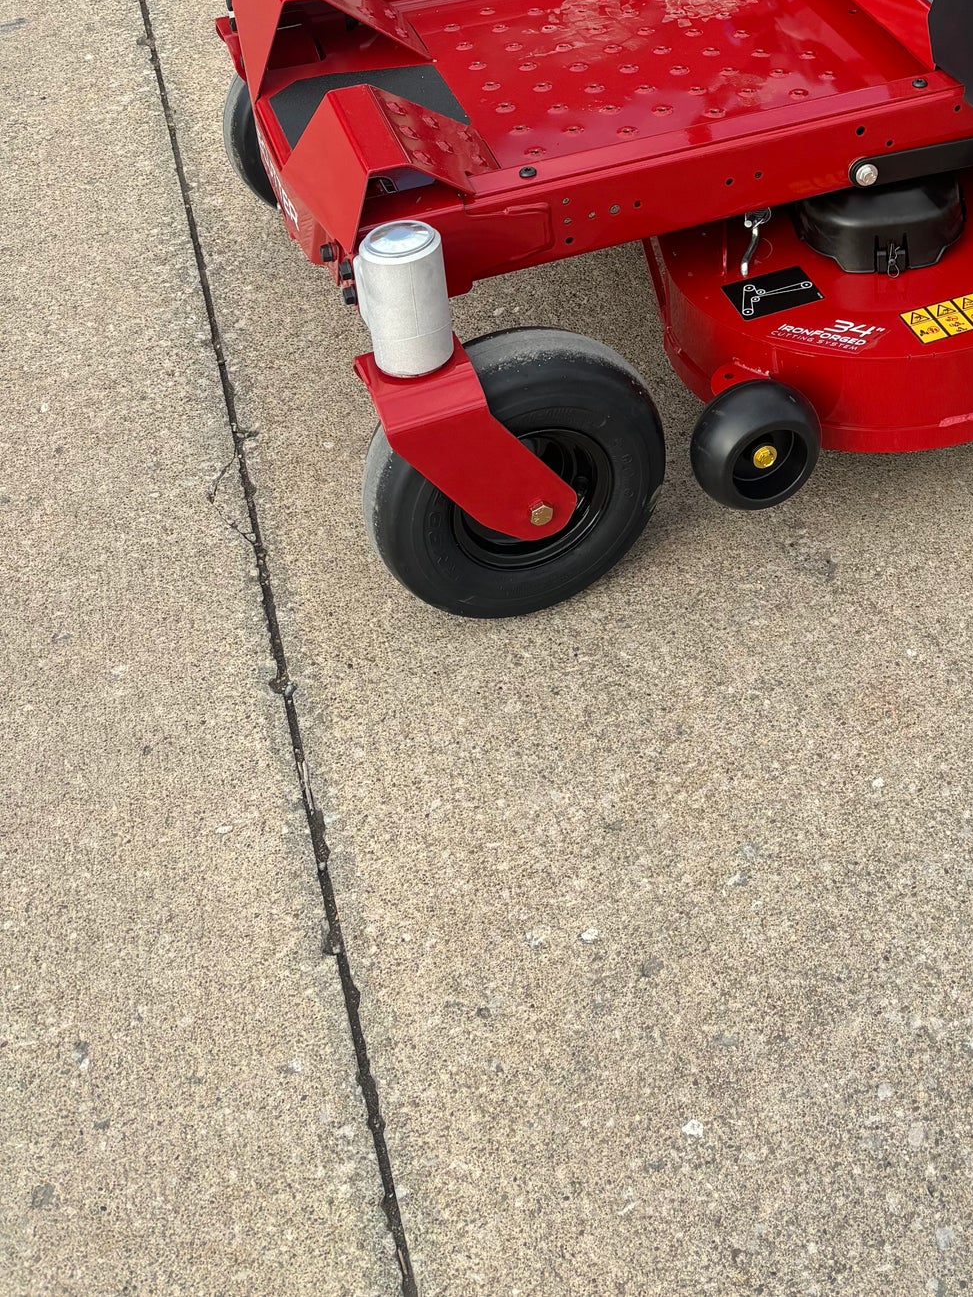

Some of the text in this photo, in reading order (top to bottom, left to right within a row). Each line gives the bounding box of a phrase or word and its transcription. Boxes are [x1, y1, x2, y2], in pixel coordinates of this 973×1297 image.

[771, 331, 858, 351] CUTTING SYSTEM
[778, 323, 867, 345] IRONFORGED
